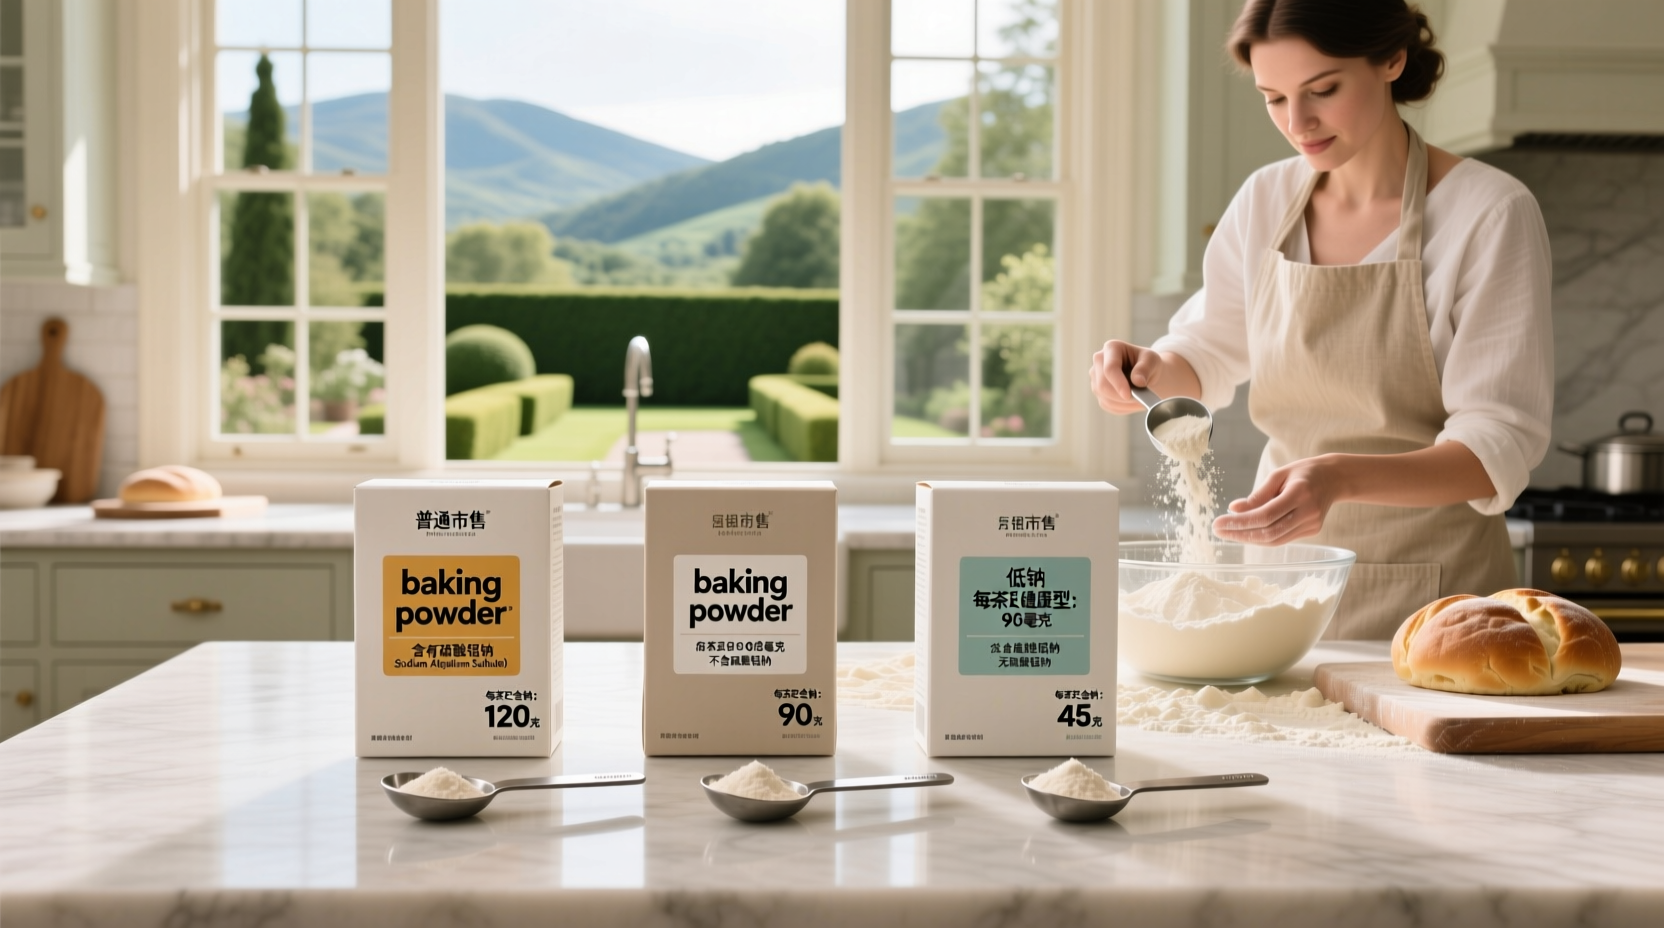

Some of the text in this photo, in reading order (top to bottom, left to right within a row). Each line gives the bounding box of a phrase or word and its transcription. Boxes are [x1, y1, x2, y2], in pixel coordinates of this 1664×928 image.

[415, 510, 486, 530] 普通市售
[402, 568, 501, 602] baking
[694, 568, 788, 601] baking
[396, 599, 508, 633] powder
[689, 597, 794, 629] powder
